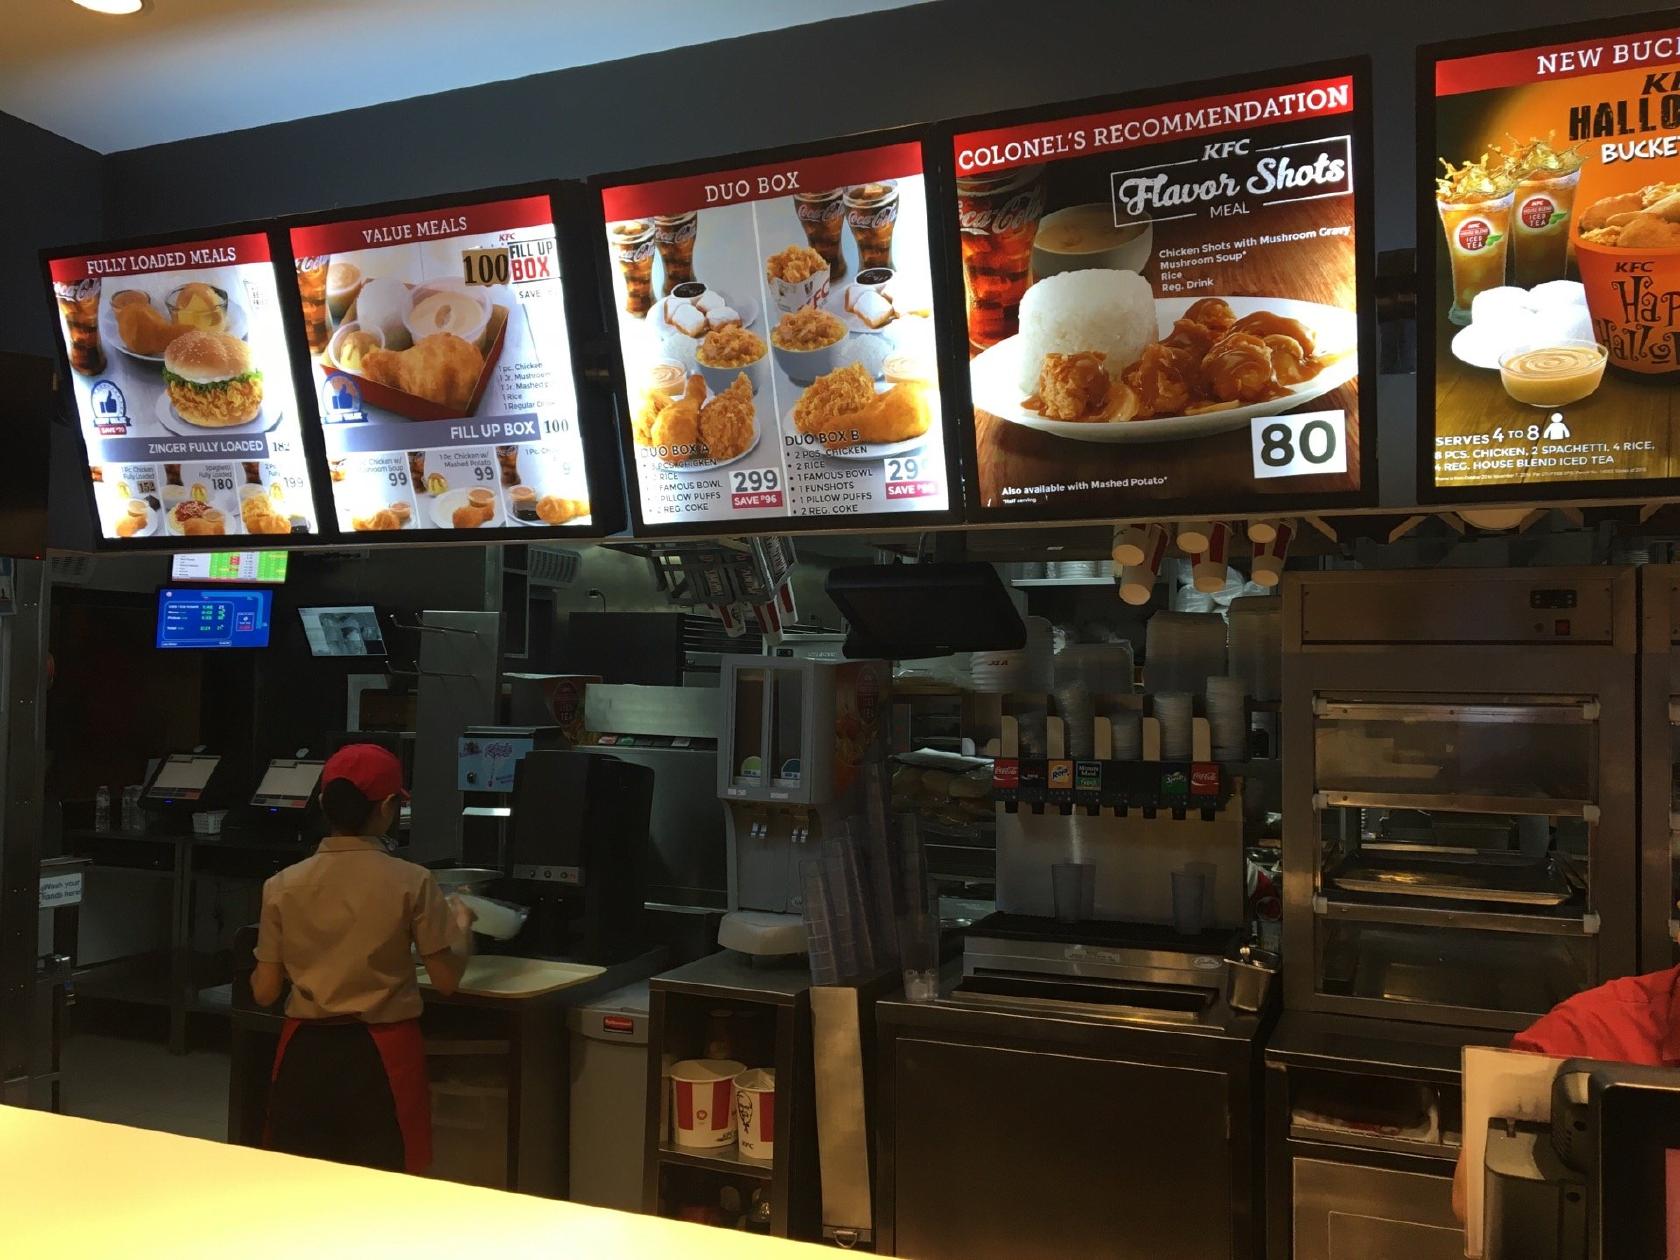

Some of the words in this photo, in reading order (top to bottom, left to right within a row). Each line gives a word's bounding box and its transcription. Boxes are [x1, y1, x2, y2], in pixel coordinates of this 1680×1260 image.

[1536, 47, 1603, 75] NEW
[1612, 36, 1680, 64] BUC
[958, 131, 1087, 170] COLONEL'S
[1093, 85, 1349, 147] RECOMMENDATION
[1201, 139, 1252, 161] KFC
[1601, 135, 1680, 164] BUCKE
[705, 180, 750, 203] DUO
[757, 171, 801, 195] BOX
[1119, 173, 1240, 216] Flavor
[1246, 152, 1346, 195] Shots
[1210, 201, 1251, 219] MEAL
[362, 225, 413, 244] VALUE
[416, 217, 467, 237] MEALS
[509, 243, 532, 259] FILL
[537, 241, 553, 255] UP
[1159, 246, 1200, 259] Chicken
[1202, 242, 1232, 254] Shots
[1234, 238, 1257, 250] with
[1259, 230, 1317, 246] Mushroom
[87, 257, 127, 275] FULLY
[130, 252, 186, 271] LOADED
[190, 247, 237, 265] MEALS
[511, 256, 550, 281] BOX
[1160, 255, 1214, 270] Mushroom
[1615, 261, 1656, 273] KFC
[463, 254, 510, 285] 100
[1161, 271, 1182, 281] Rice
[1162, 282, 1185, 293] Reg.
[1186, 278, 1214, 290] Drink
[451, 426, 479, 440] FILL
[481, 424, 501, 438] UP
[504, 421, 536, 436] BOX
[543, 419, 569, 434] 100
[785, 434, 815, 446] DUO
[818, 431, 848, 444] BOX
[851, 430, 860, 441] B
[1261, 420, 1336, 467] 80
[1435, 435, 1489, 447] SERVES
[1492, 427, 1504, 443] 4
[1507, 430, 1523, 439] TO
[1527, 425, 1539, 441] 8
[148, 443, 187, 455] ZINGER
[189, 441, 218, 454] FULLY
[221, 440, 264, 452] LOADED
[671, 444, 699, 456] BOX
[701, 444, 710, 453] A
[794, 451, 800, 459] 2
[825, 445, 868, 457] CHICKEN
[1444, 450, 1470, 460] PCS.
[1531, 446, 1538, 455] 2
[1613, 442, 1621, 451] 4
[804, 461, 825, 470] RICE
[888, 458, 930, 481] 29
[1443, 461, 1470, 471] REG.
[1473, 459, 1513, 470] HOUSE
[1516, 457, 1557, 468] BLEND
[1559, 456, 1588, 466] ICED
[1591, 455, 1615, 465] TEA
[388, 472, 408, 486] 99
[473, 466, 495, 481] 99
[660, 472, 678, 480] RICE
[733, 469, 778, 493] 299
[803, 472, 844, 481] FAMOUS
[846, 469, 873, 479] BOWL
[211, 478, 233, 490] 180
[284, 477, 304, 488] 199
[659, 482, 695, 491] FAMOUS
[696, 480, 723, 490] BOWL
[805, 482, 854, 493] FUNSHOTS
[1001, 487, 1022, 496] Also
[1023, 483, 1065, 494] available
[1067, 481, 1089, 491] with
[1091, 478, 1129, 489] Mashed
[661, 493, 692, 502] PILLOW
[694, 492, 721, 501] PUFFS
[806, 494, 840, 503] PILLOW
[843, 492, 873, 502] PUFFS
[888, 486, 915, 496] SAVE
[685, 503, 709, 512] COKE
[734, 496, 759, 506] SAVE
[808, 506, 831, 515] REG.
[832, 504, 858, 513] COKE
